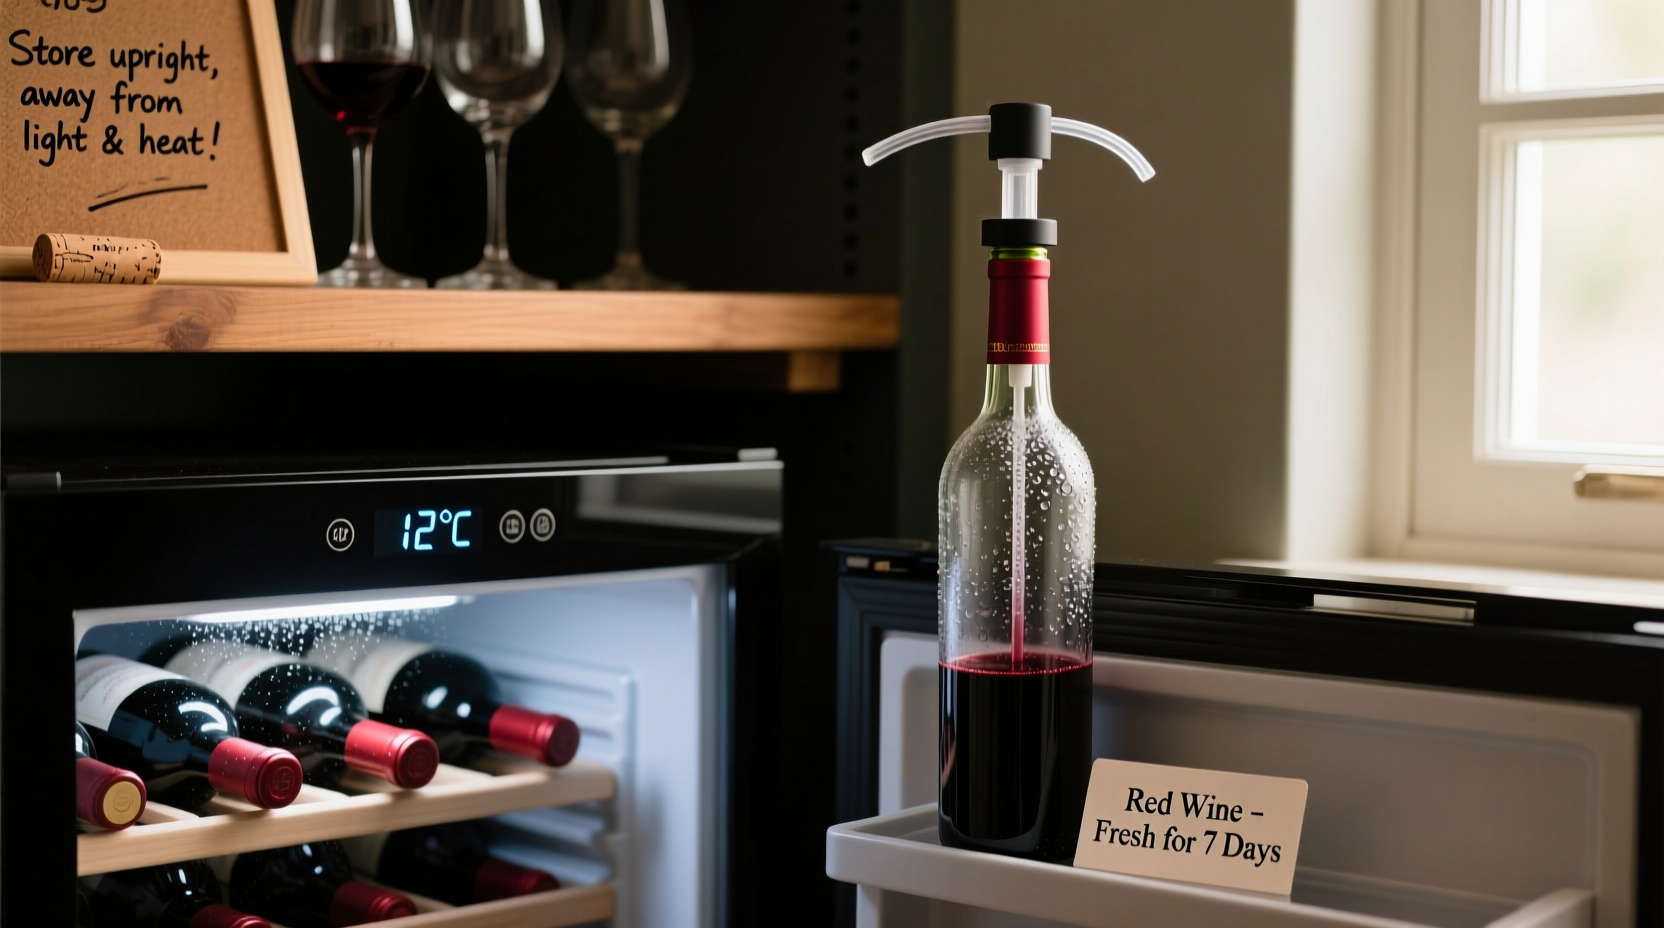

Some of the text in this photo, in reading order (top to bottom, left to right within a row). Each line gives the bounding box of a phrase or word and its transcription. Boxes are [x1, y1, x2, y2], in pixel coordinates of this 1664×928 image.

[8, 28, 219, 84] Store upright,
[20, 80, 183, 123] away from
[23, 119, 221, 167] light & heat!
[402, 508, 472, 550] 12°C
[1124, 787, 1174, 816] Red
[1180, 791, 1243, 823] Wine
[1092, 818, 1282, 868] Fresh for 7 Days
